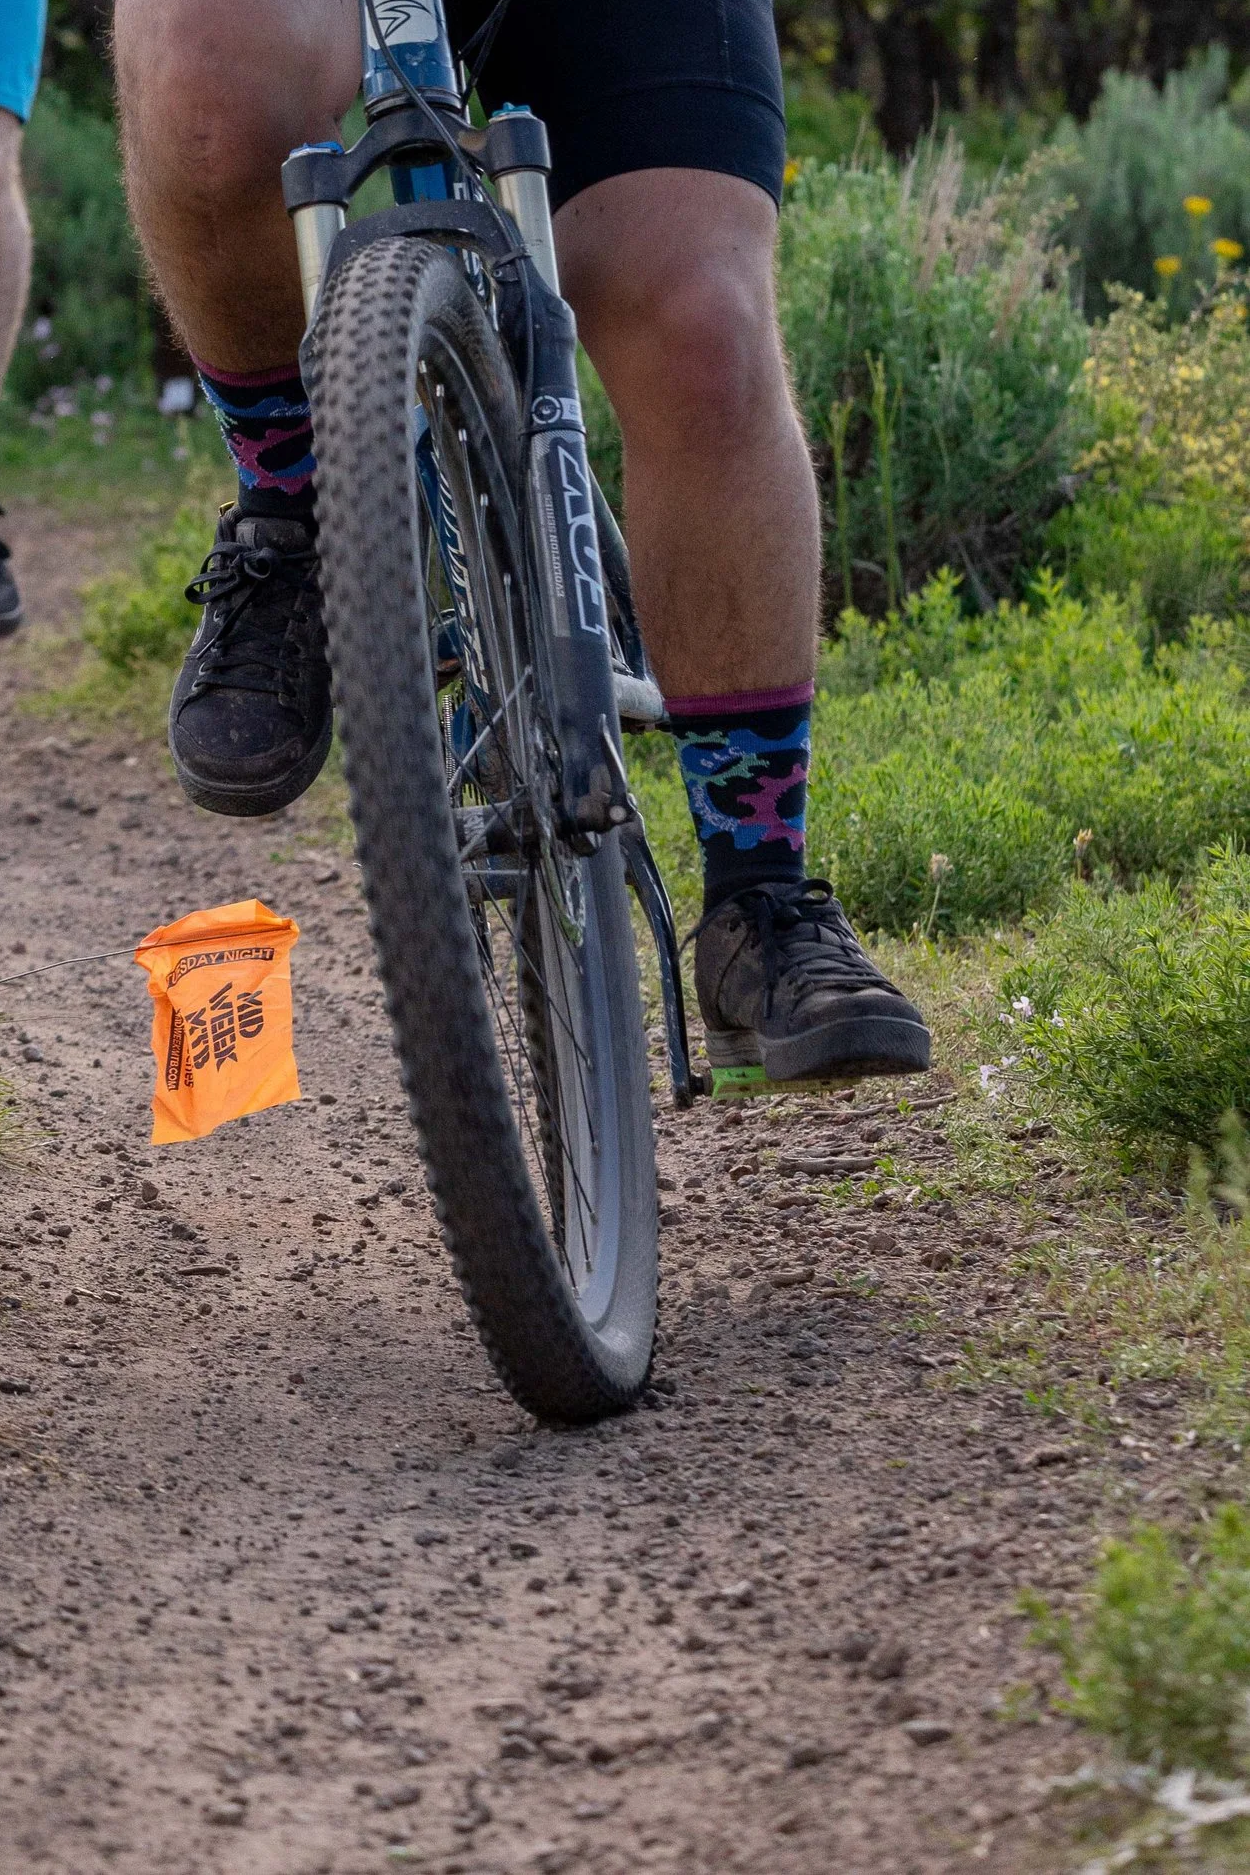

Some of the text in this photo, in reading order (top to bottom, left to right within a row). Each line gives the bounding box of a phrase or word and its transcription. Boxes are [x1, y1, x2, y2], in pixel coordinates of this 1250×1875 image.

[545, 493, 565, 598] EVOLUTION SERIES
[165, 947, 274, 989] TUESDAY NIGHT
[185, 1006, 210, 1070] MTB
[209, 981, 239, 1073] WEEK
[237, 990, 265, 1039] MID
